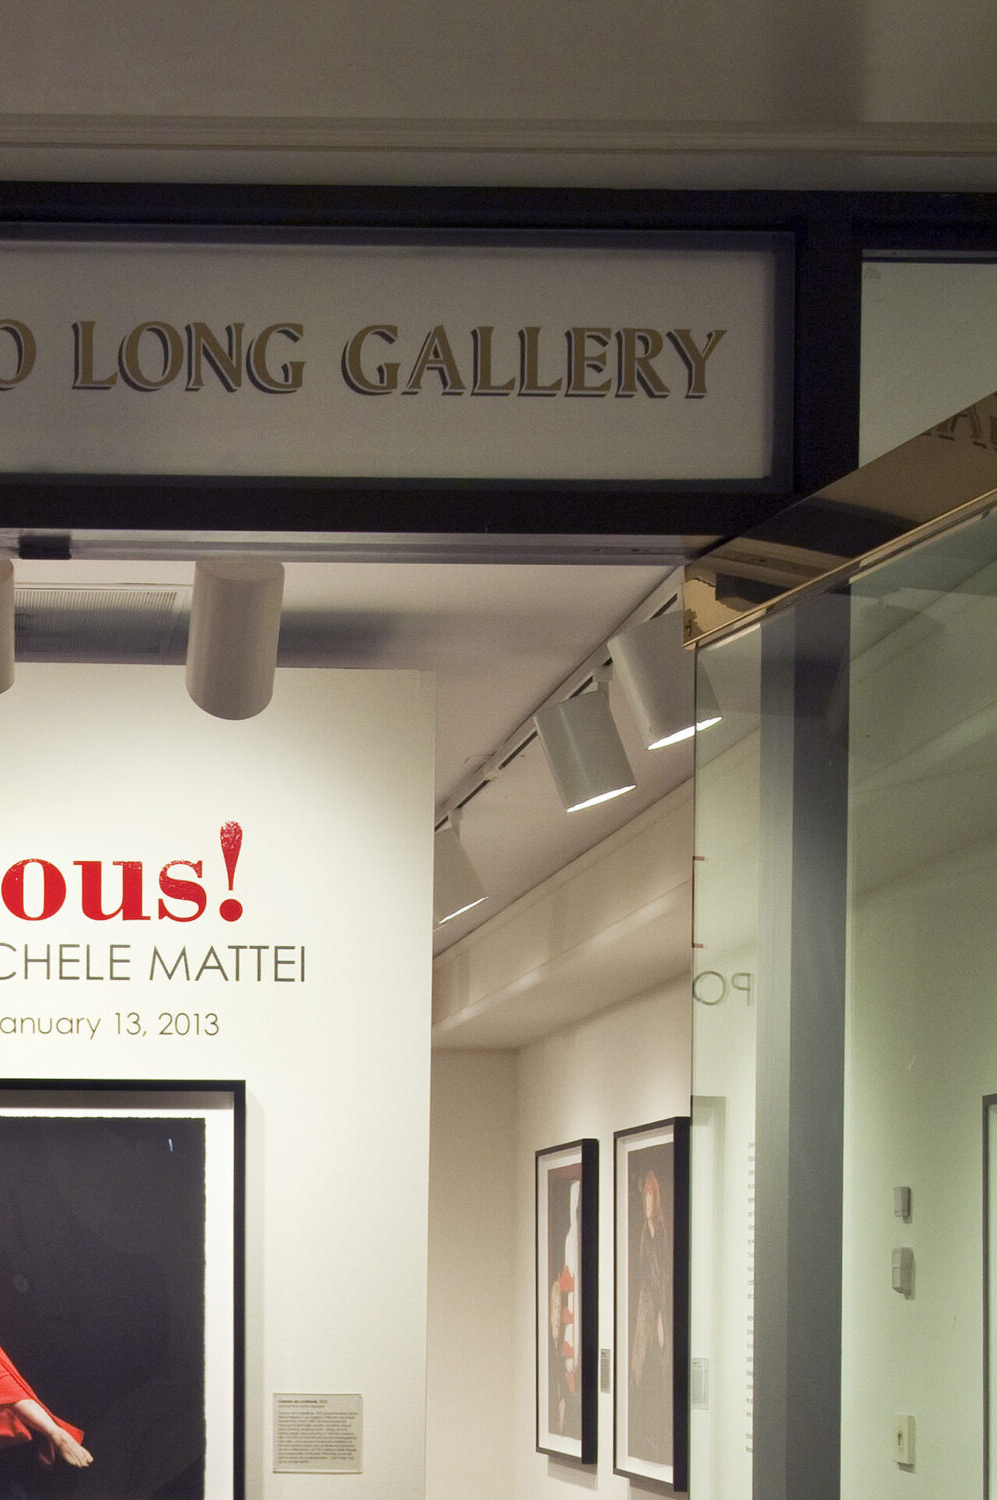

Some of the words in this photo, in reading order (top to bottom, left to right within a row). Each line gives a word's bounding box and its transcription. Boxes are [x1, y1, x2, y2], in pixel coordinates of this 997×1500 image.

[71, 320, 305, 394] LONG
[341, 324, 728, 400] GALLERY
[149, 944, 306, 983] MATTEI
[114, 1012, 147, 1037] 13,
[157, 1012, 221, 1037] 2013
